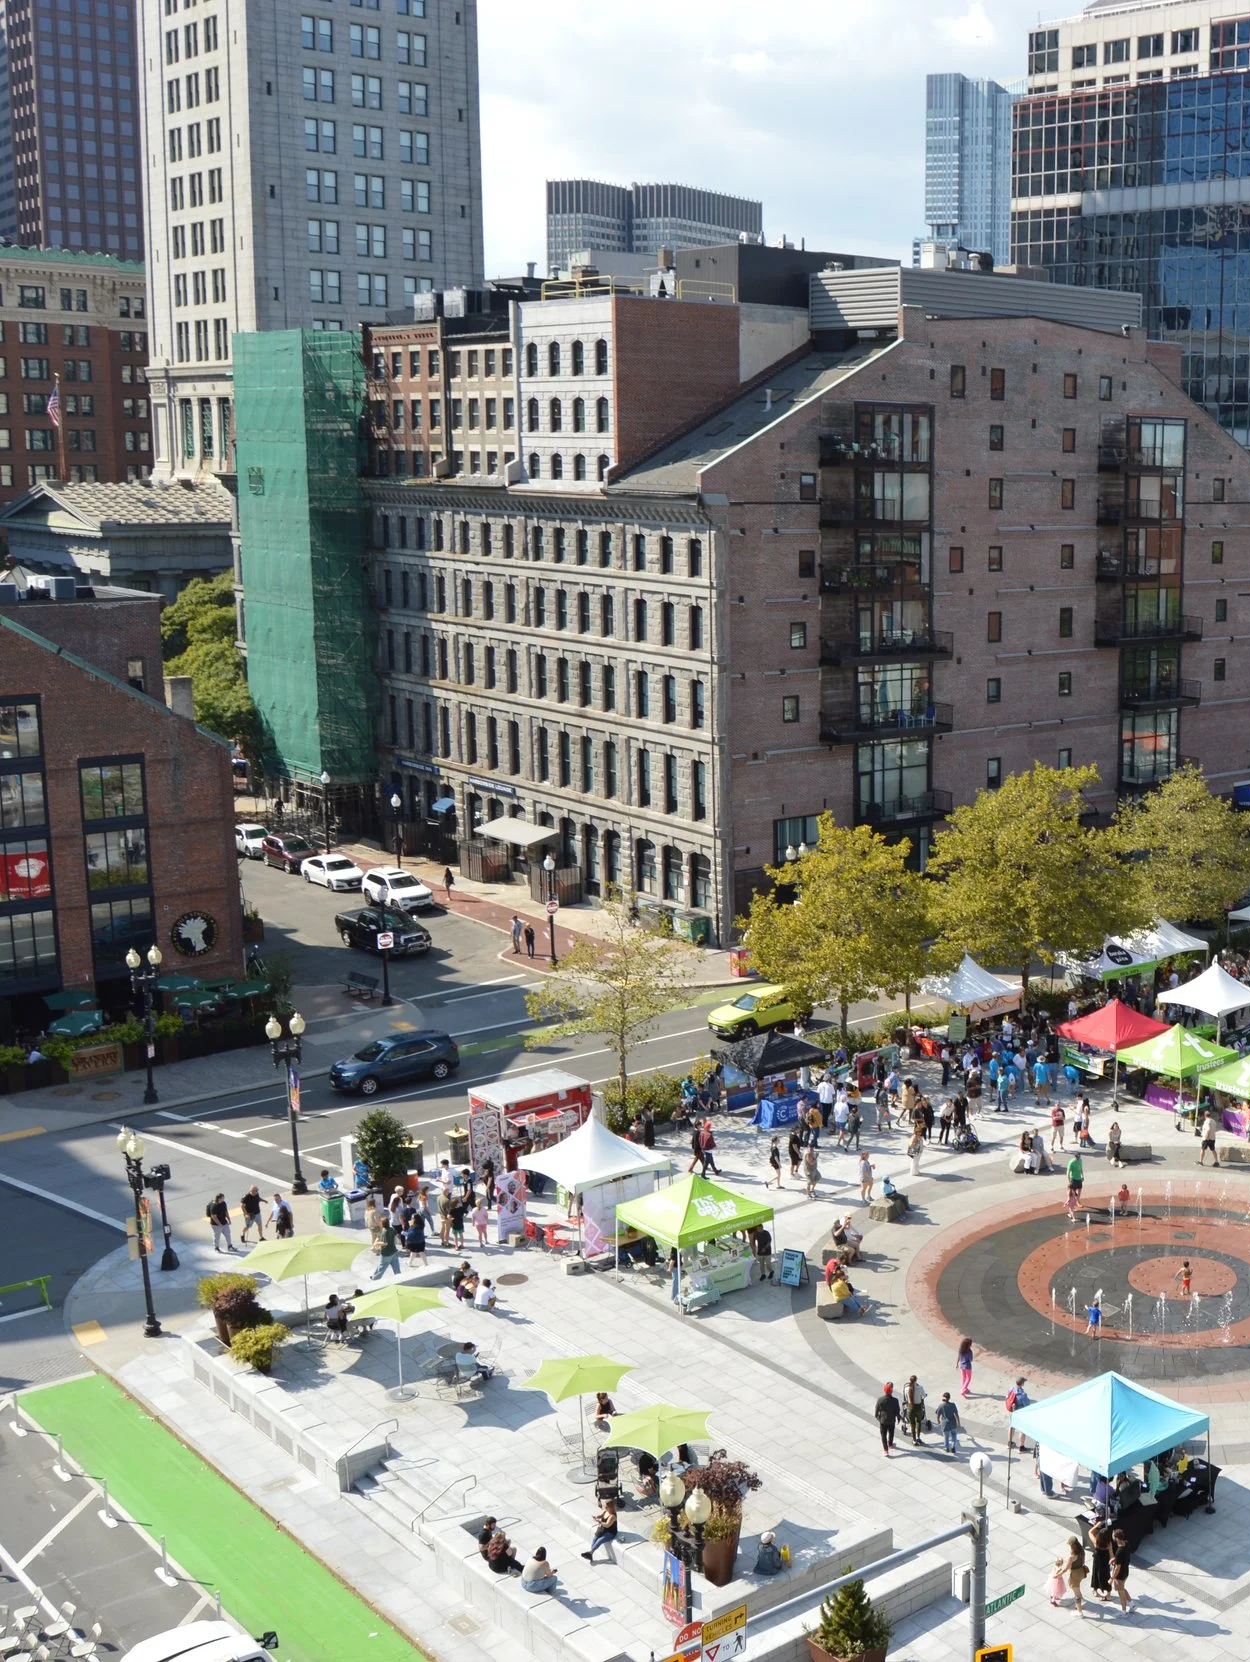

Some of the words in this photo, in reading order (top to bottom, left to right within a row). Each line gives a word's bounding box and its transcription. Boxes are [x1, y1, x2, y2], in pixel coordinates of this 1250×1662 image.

[1196, 1058, 1225, 1073] trustees
[986, 1591, 1016, 1616] ATLANTIC
[706, 1616, 733, 1632] TURNING
[679, 1634, 689, 1643] DO
[692, 1628, 702, 1637] NO
[705, 1625, 733, 1641] VEHICLES
[722, 1644, 730, 1652] TO
